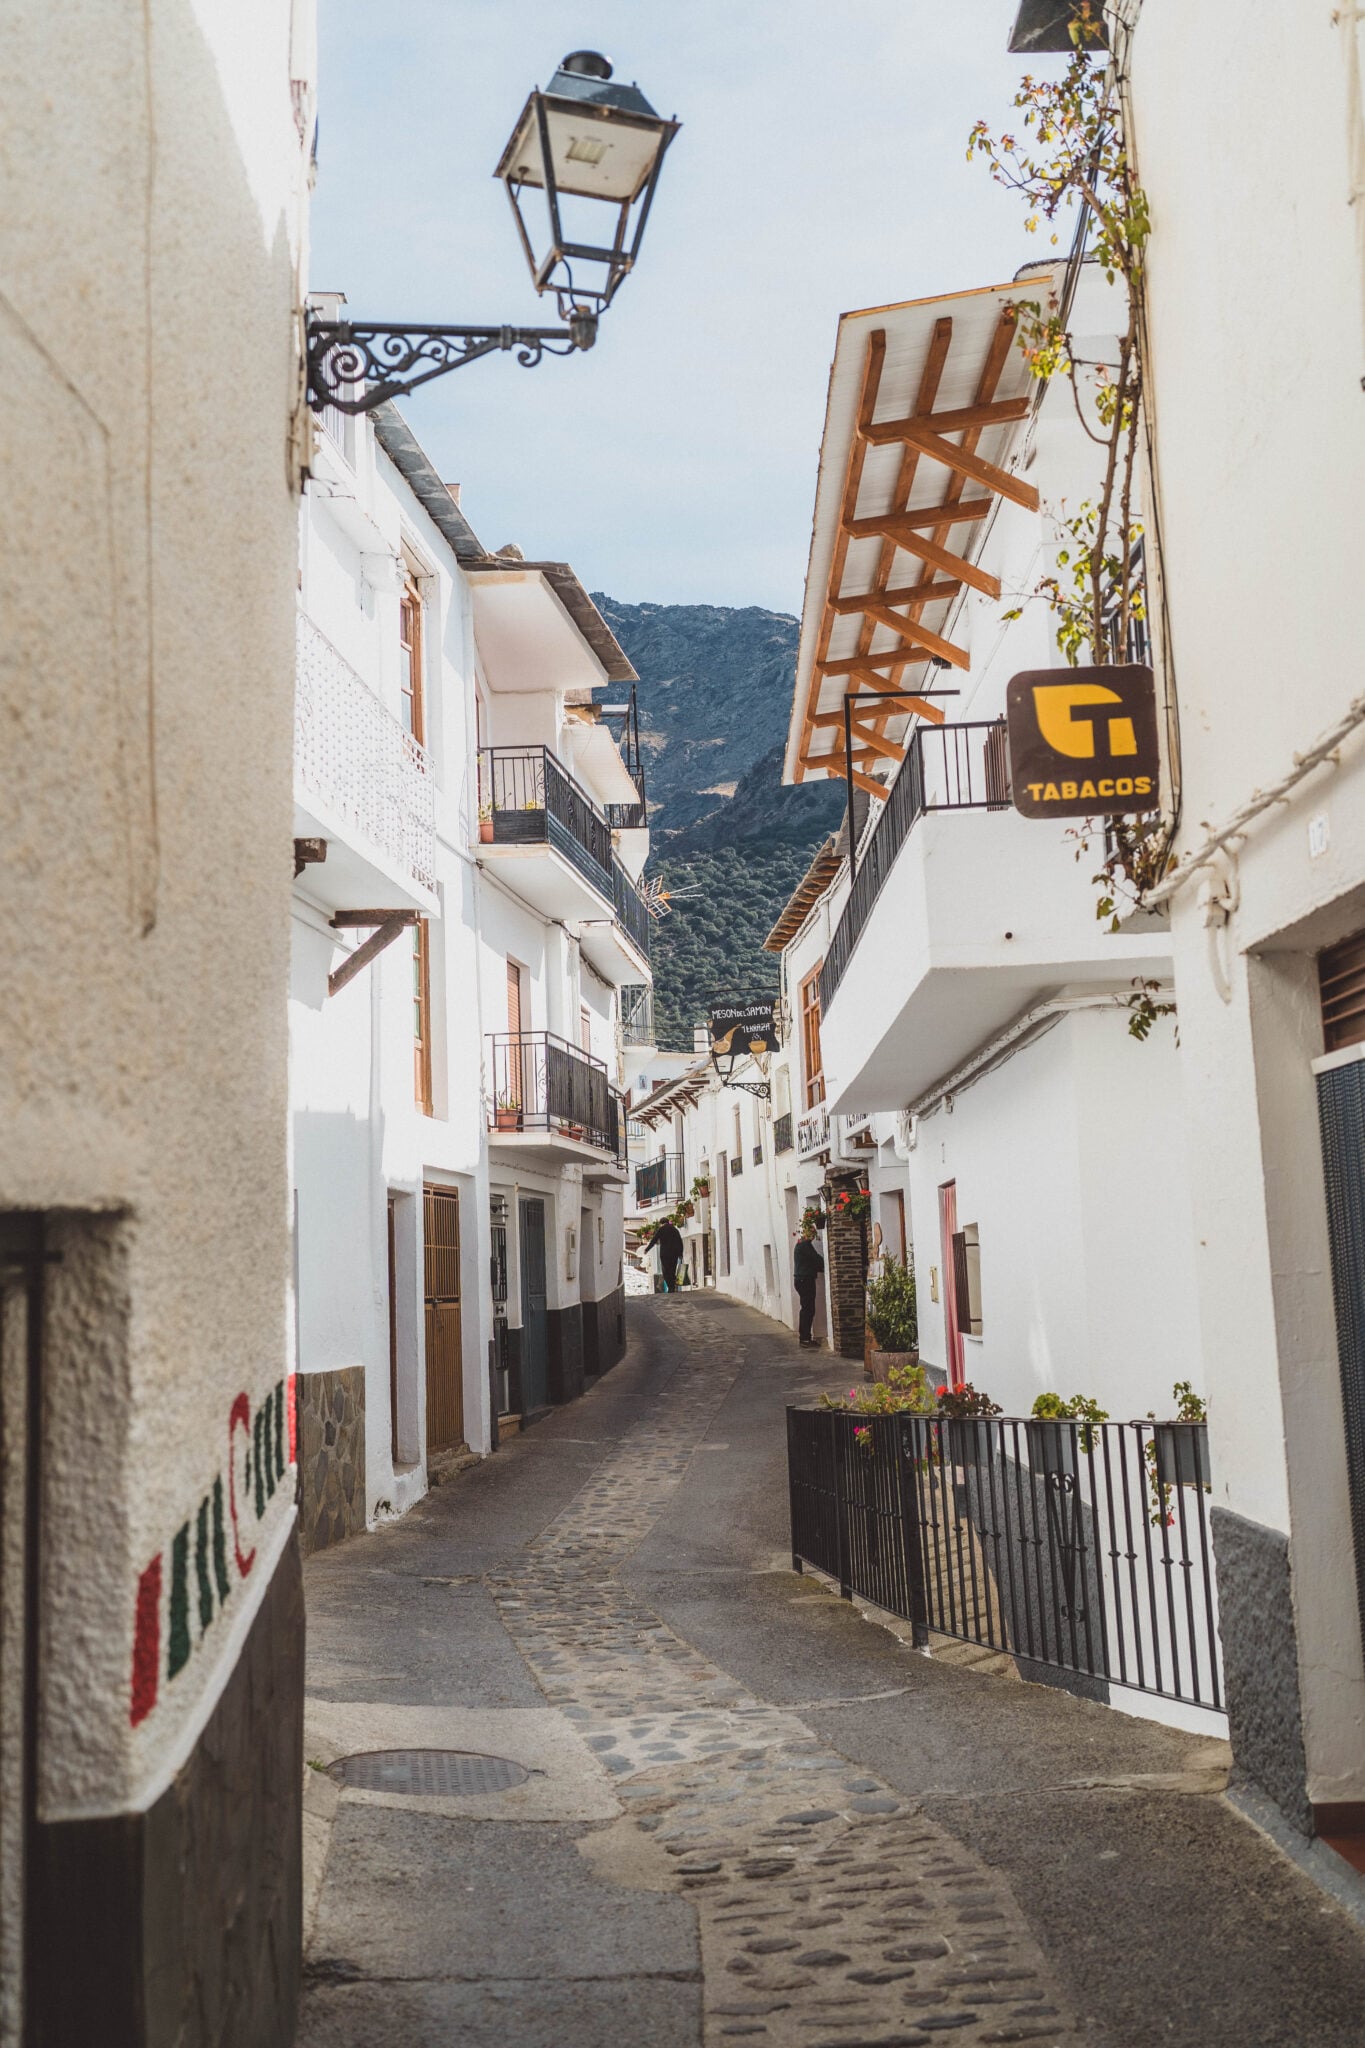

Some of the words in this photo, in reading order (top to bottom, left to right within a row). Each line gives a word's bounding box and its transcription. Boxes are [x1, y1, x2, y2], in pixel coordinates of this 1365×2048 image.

[1027, 776, 1152, 801] TABACOS
[711, 1009, 737, 1019] MESON
[745, 1006, 771, 1016] JAMON
